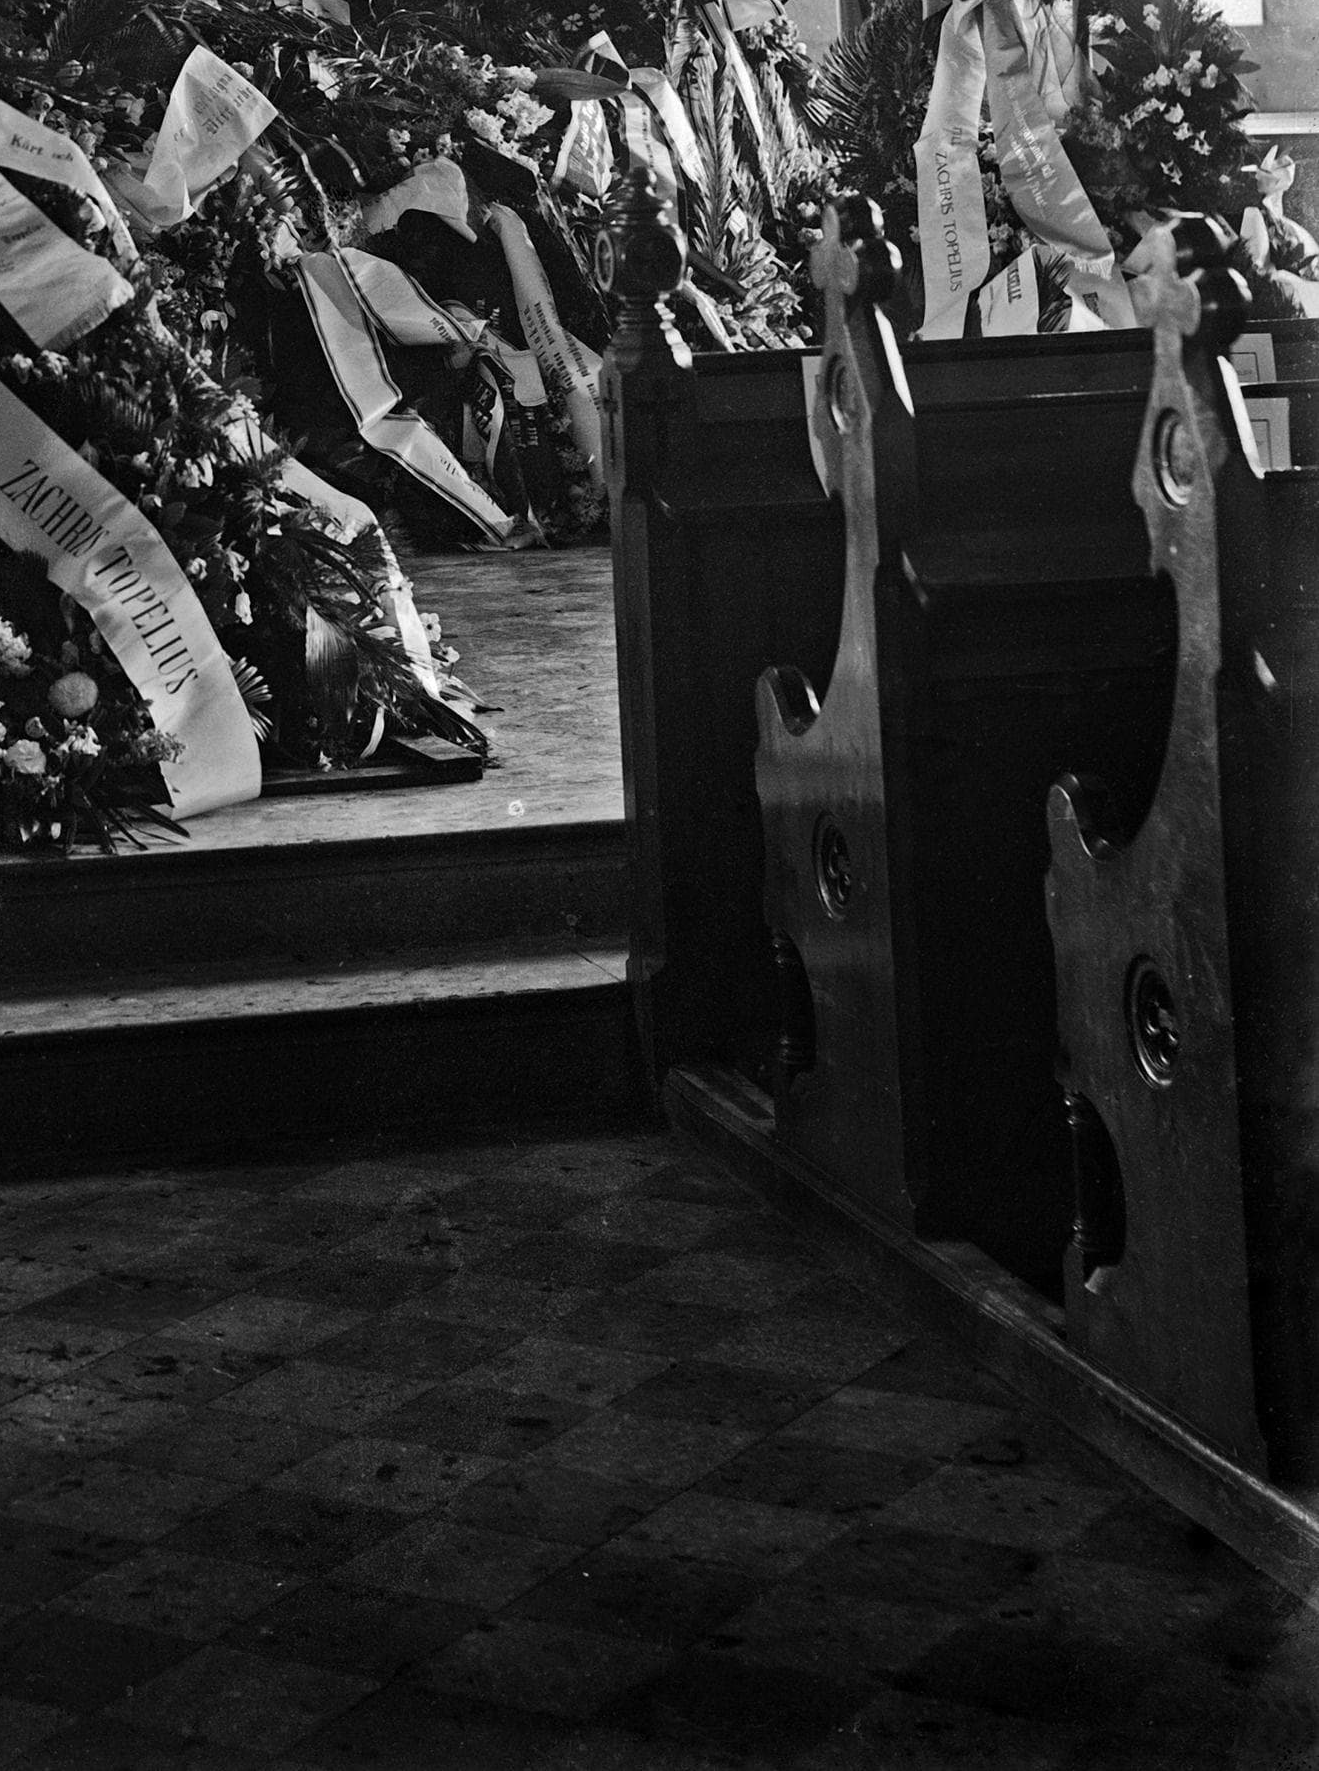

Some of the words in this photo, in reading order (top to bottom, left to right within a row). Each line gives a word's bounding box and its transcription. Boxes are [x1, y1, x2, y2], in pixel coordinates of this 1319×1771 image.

[935, 151, 955, 216] ZACHRIS
[943, 219, 963, 292] TOPELIUS
[94, 545, 199, 695] TOPELIUS
